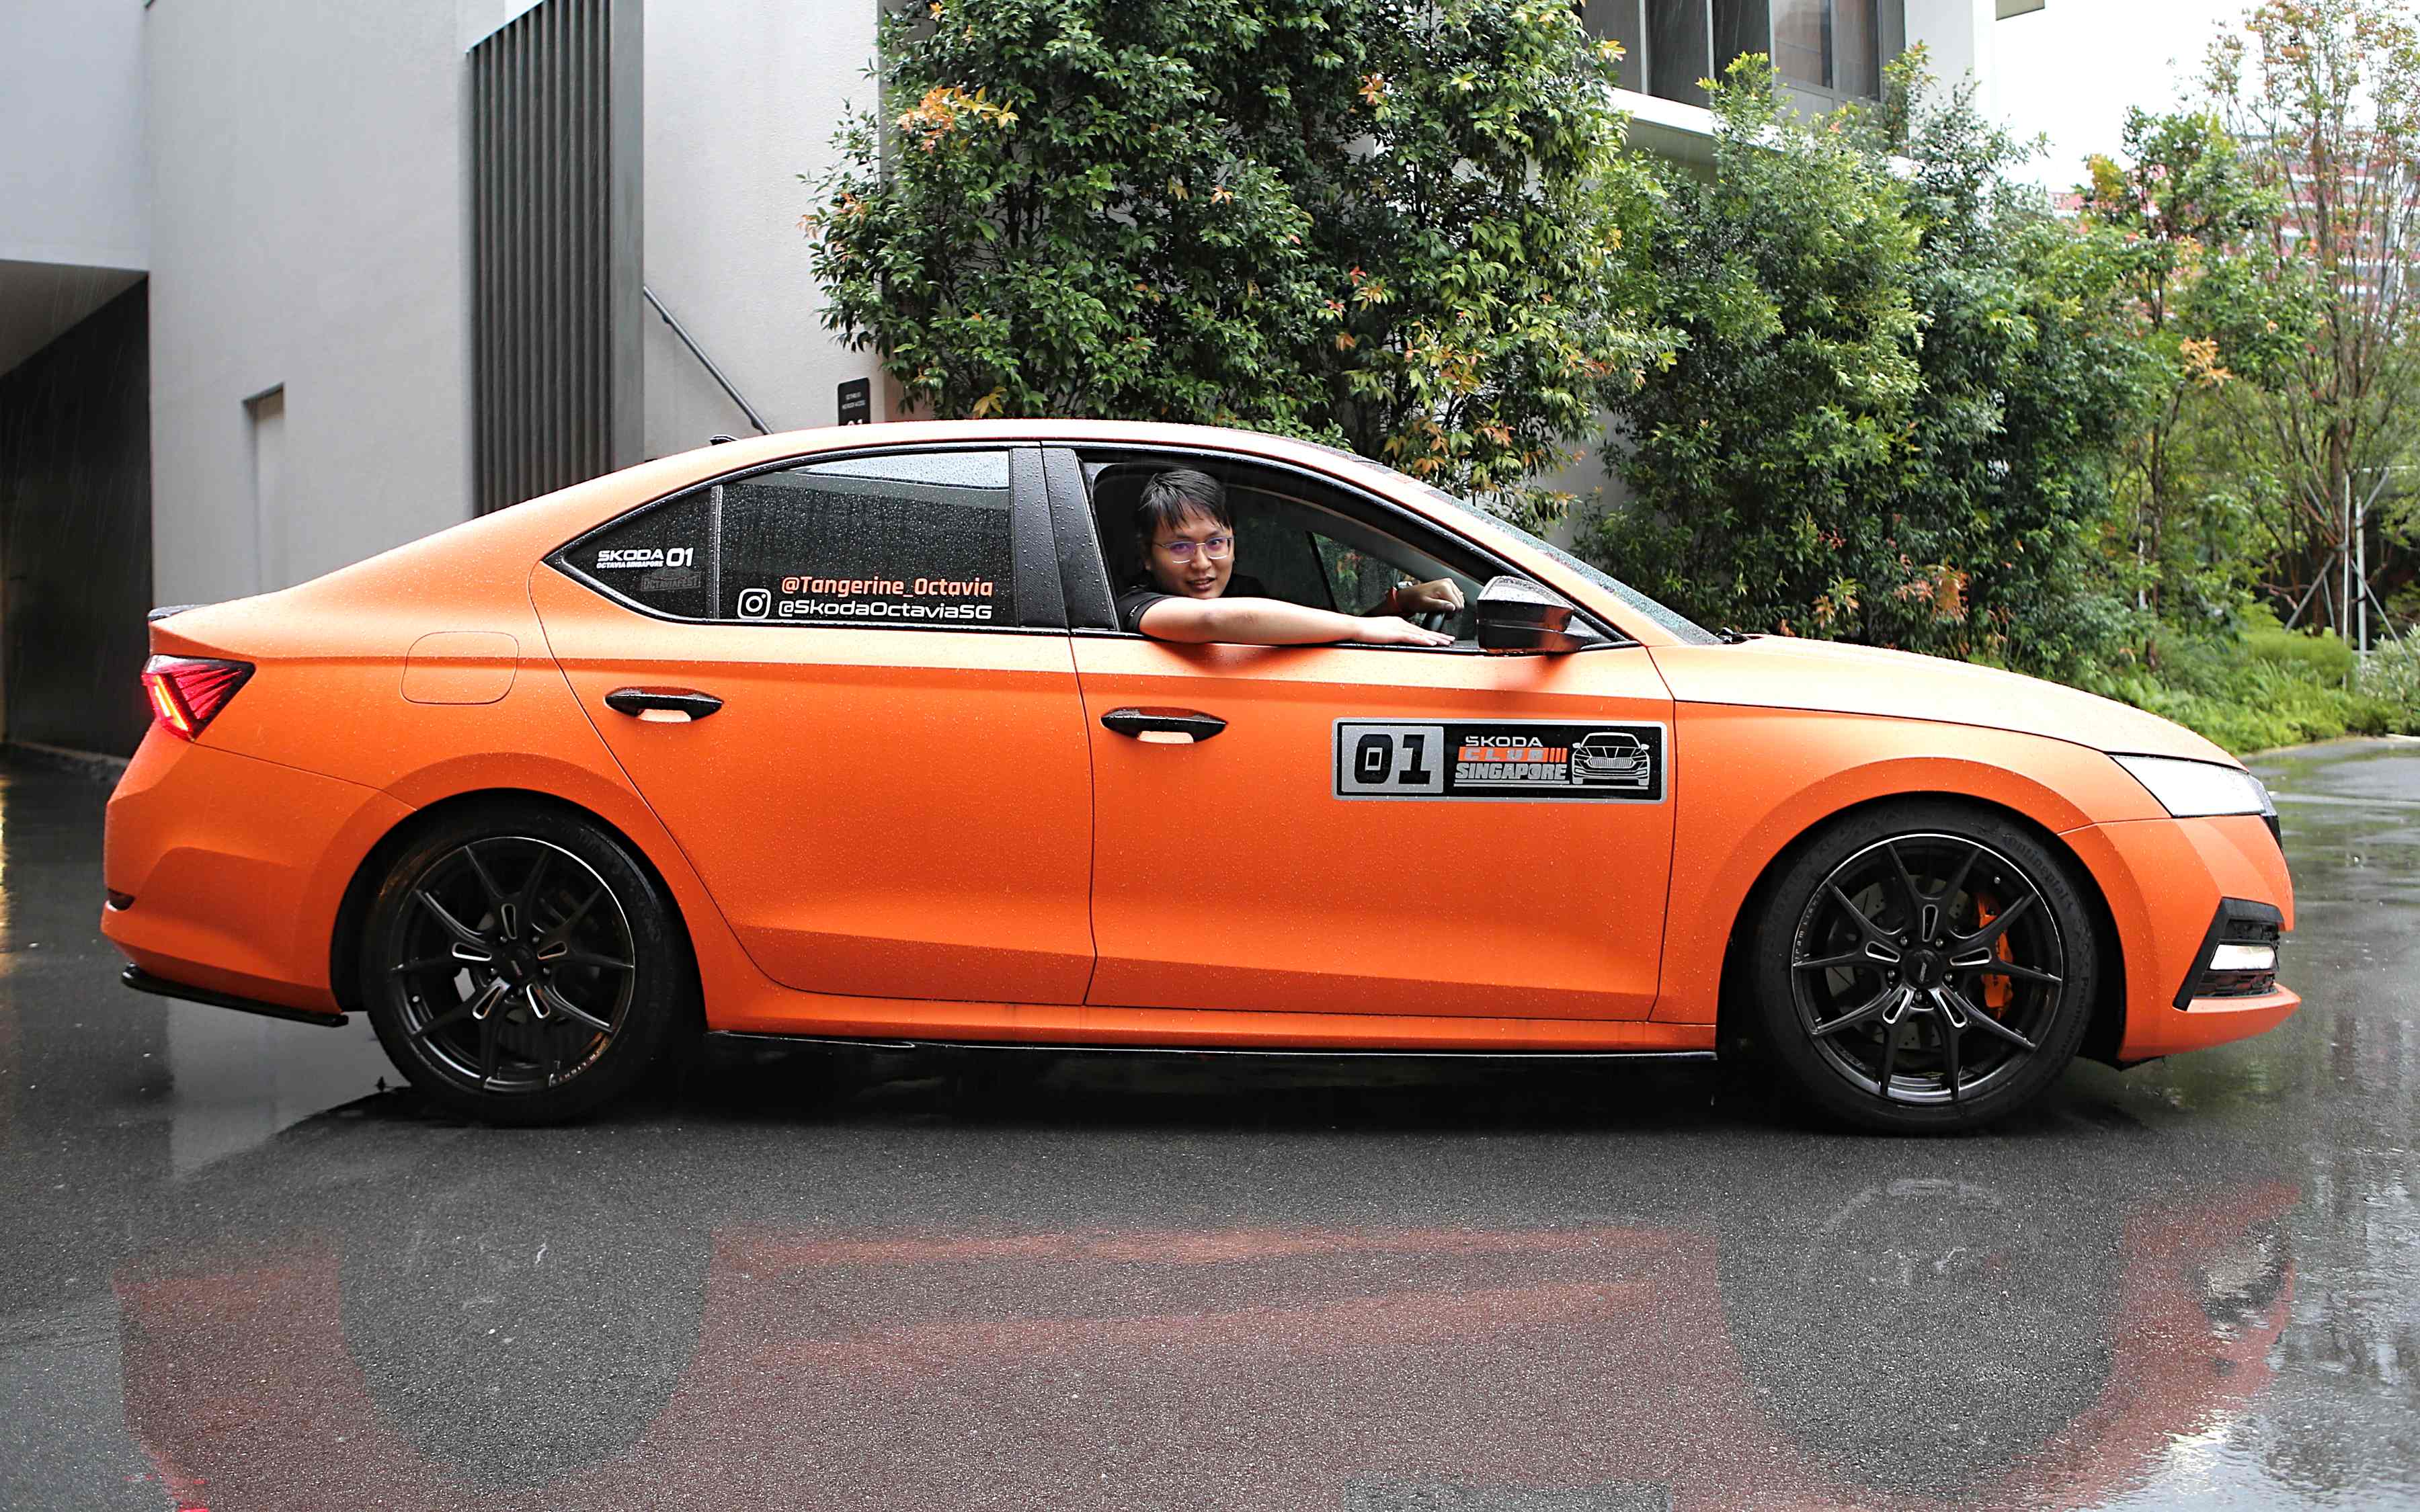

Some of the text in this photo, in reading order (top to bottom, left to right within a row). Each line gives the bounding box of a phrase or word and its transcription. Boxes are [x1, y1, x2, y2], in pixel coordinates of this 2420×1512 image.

[598, 547, 694, 567] SKODA 01
[781, 575, 994, 597] @Tangerine_Octavia
[778, 599, 993, 620] @SkodaOctaviaSG
[1354, 733, 1435, 785] 01
[1464, 748, 1545, 761] CLUB
[1455, 763, 1568, 780] SINGAPORE
